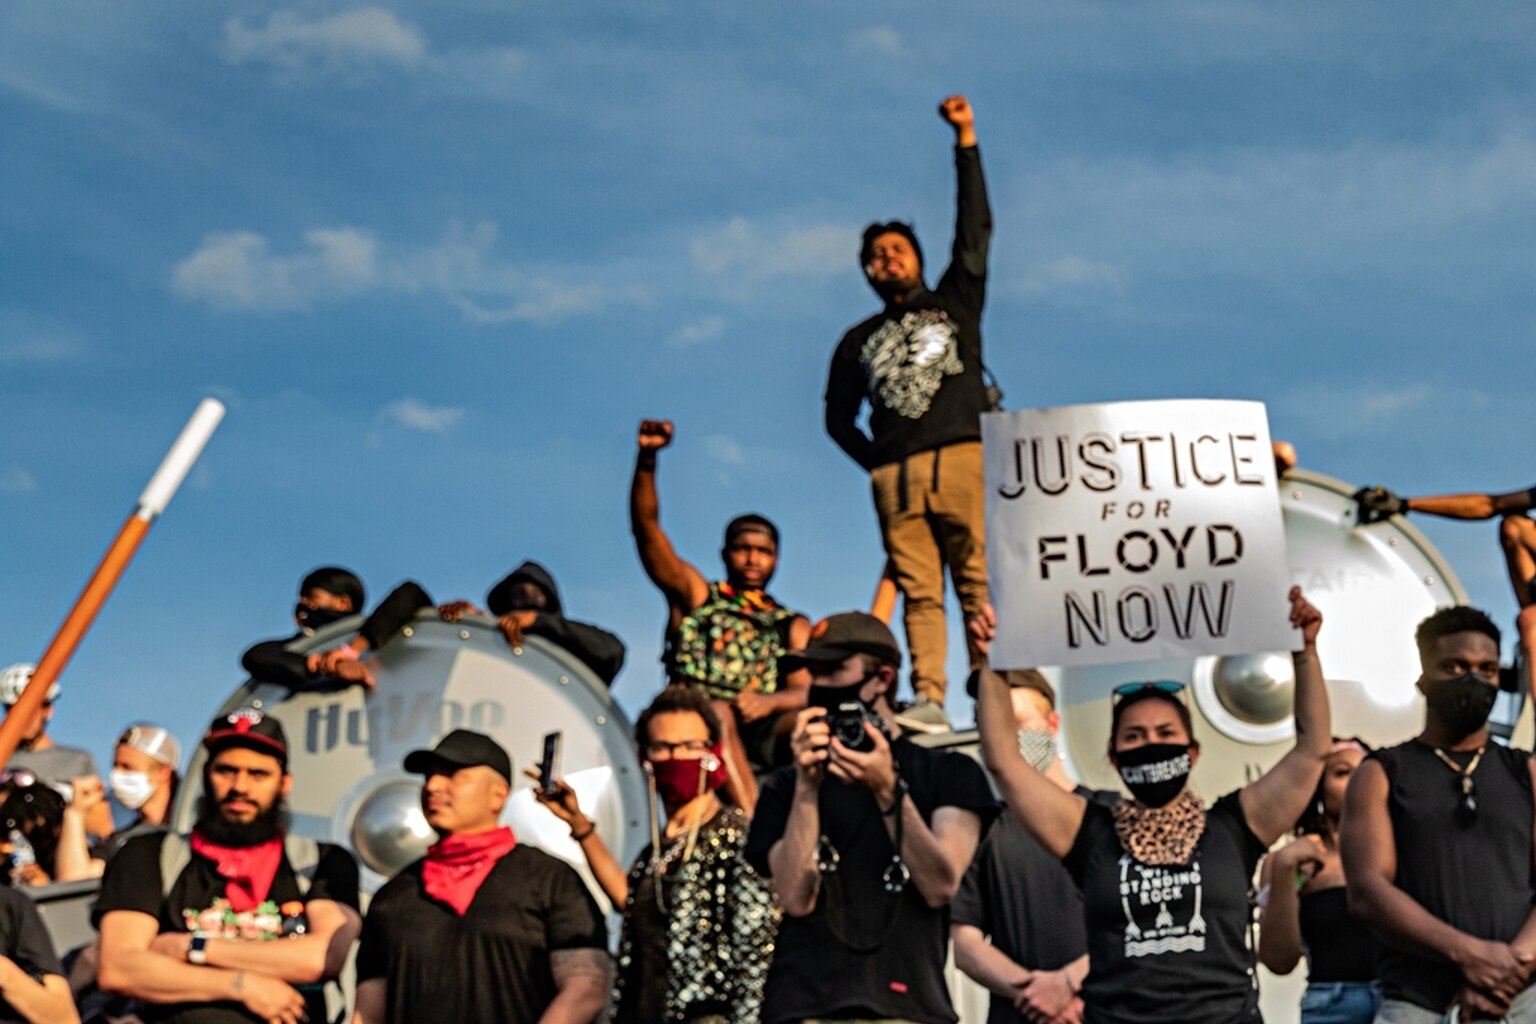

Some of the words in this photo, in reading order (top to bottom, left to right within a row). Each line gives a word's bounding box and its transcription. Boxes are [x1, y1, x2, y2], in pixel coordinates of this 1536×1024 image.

[998, 431, 1264, 499] JUSTICE
[1101, 500, 1171, 521] FOR
[1038, 524, 1244, 580] FLOYD
[1064, 580, 1234, 648] NOW
[1119, 871, 1202, 895] STANDING
[1140, 886, 1183, 906] ROCK
